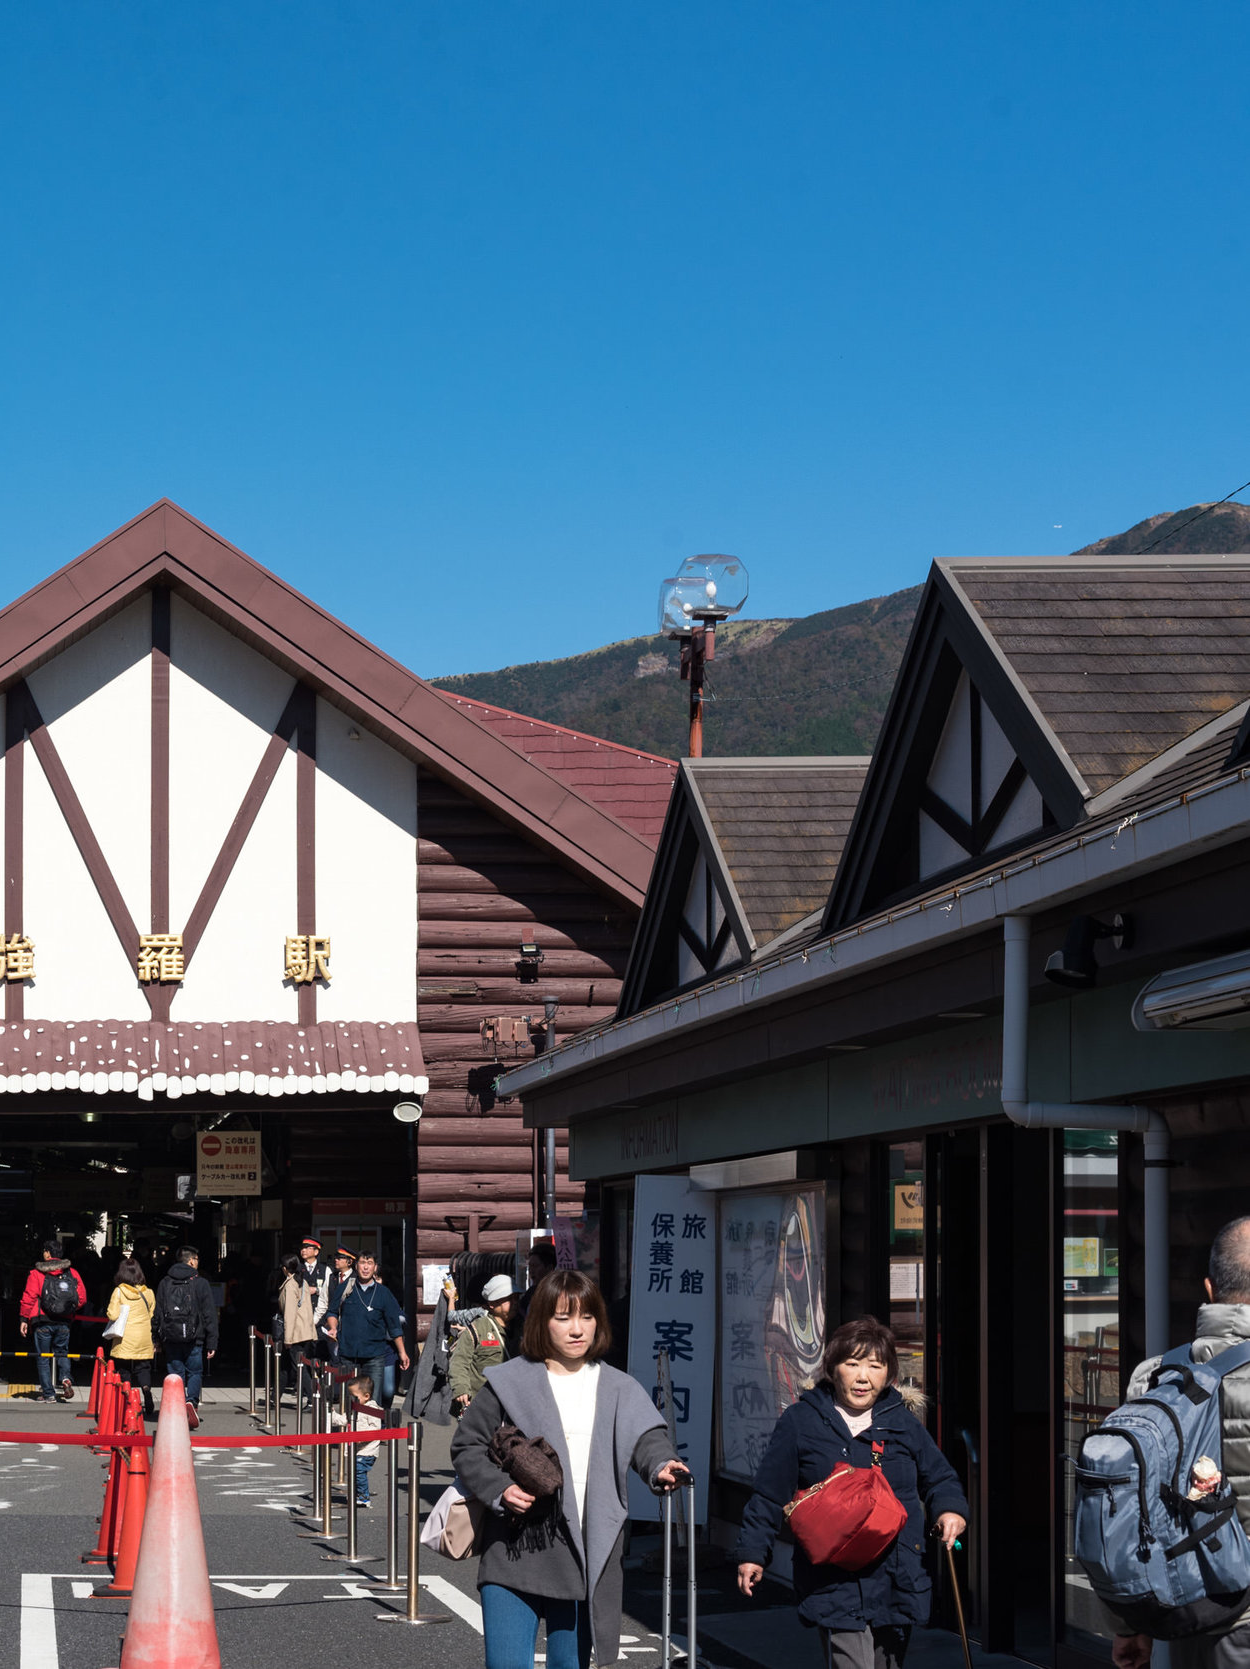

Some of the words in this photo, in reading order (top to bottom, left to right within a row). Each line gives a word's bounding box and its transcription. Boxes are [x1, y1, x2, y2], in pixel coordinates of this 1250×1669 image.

[620, 1111, 678, 1161] INFORMATION
[647, 1212, 675, 1294] 保養所
[681, 1213, 707, 1295] 旅館
